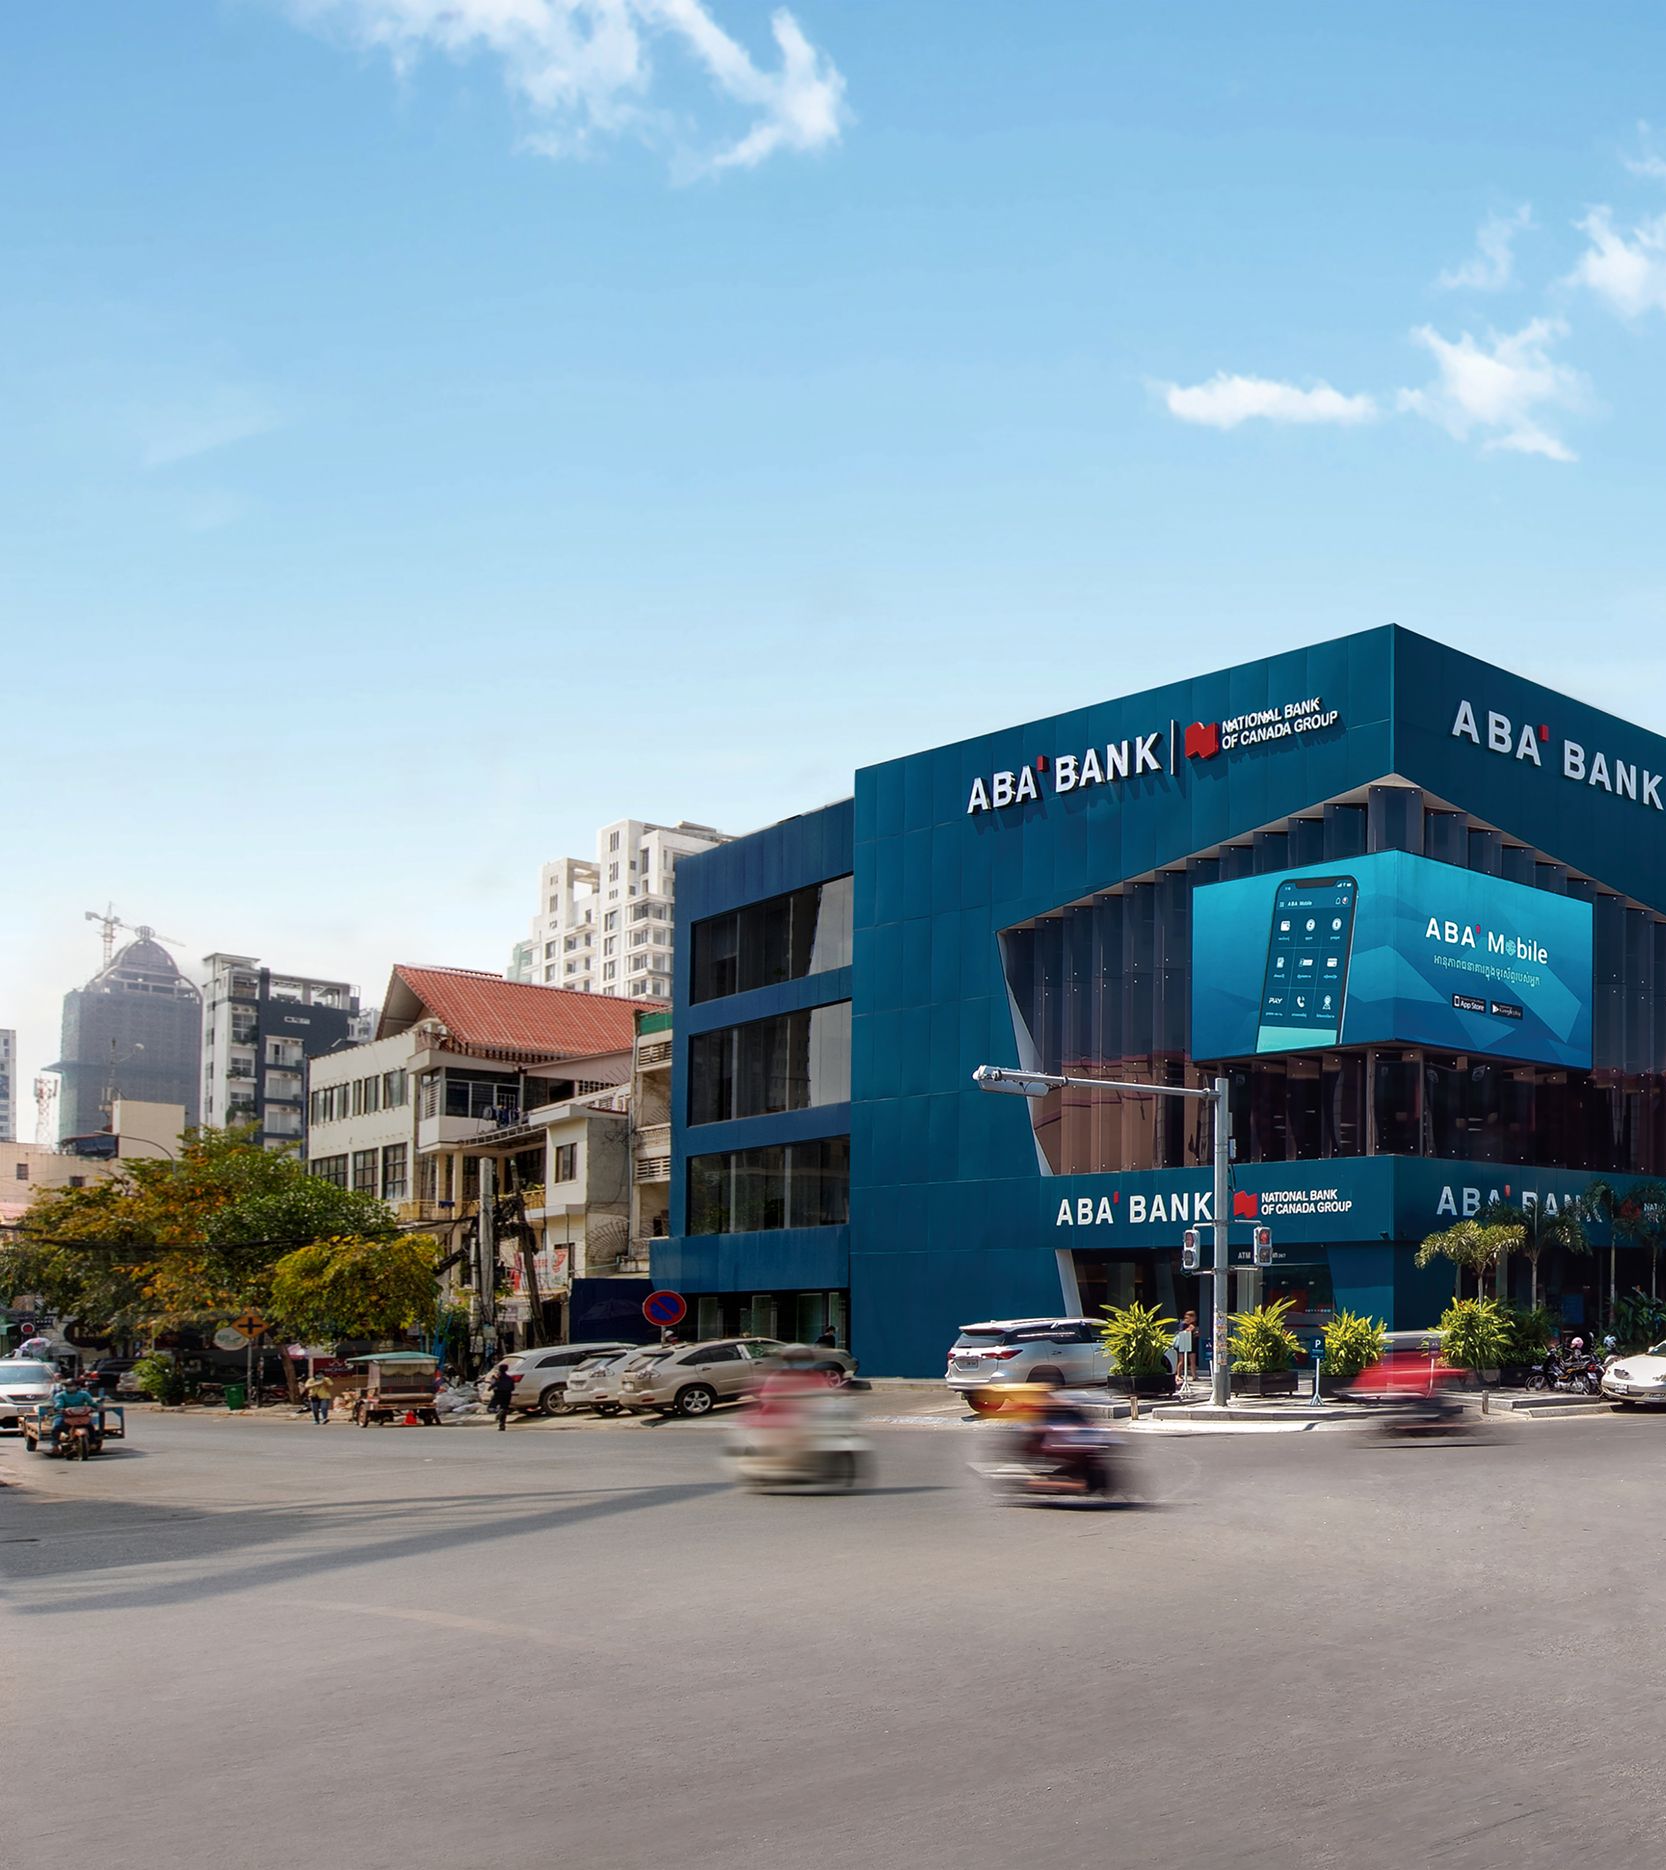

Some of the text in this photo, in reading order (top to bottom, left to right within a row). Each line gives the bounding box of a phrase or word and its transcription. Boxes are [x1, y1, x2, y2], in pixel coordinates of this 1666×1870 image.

[1221, 710, 1338, 750] OF CANADA GROUP
[1222, 696, 1320, 734] NATIONAL BANK
[1055, 731, 1161, 794] BANK
[1563, 739, 1663, 811] BANK
[1460, 1000, 1485, 1011] App Store
[1129, 1191, 1214, 1224] BANK
[1261, 1189, 1338, 1203] NATIONAL BANK
[1261, 1200, 1352, 1215] OF CANADA GROUP
[1315, 1340, 1321, 1348] P
